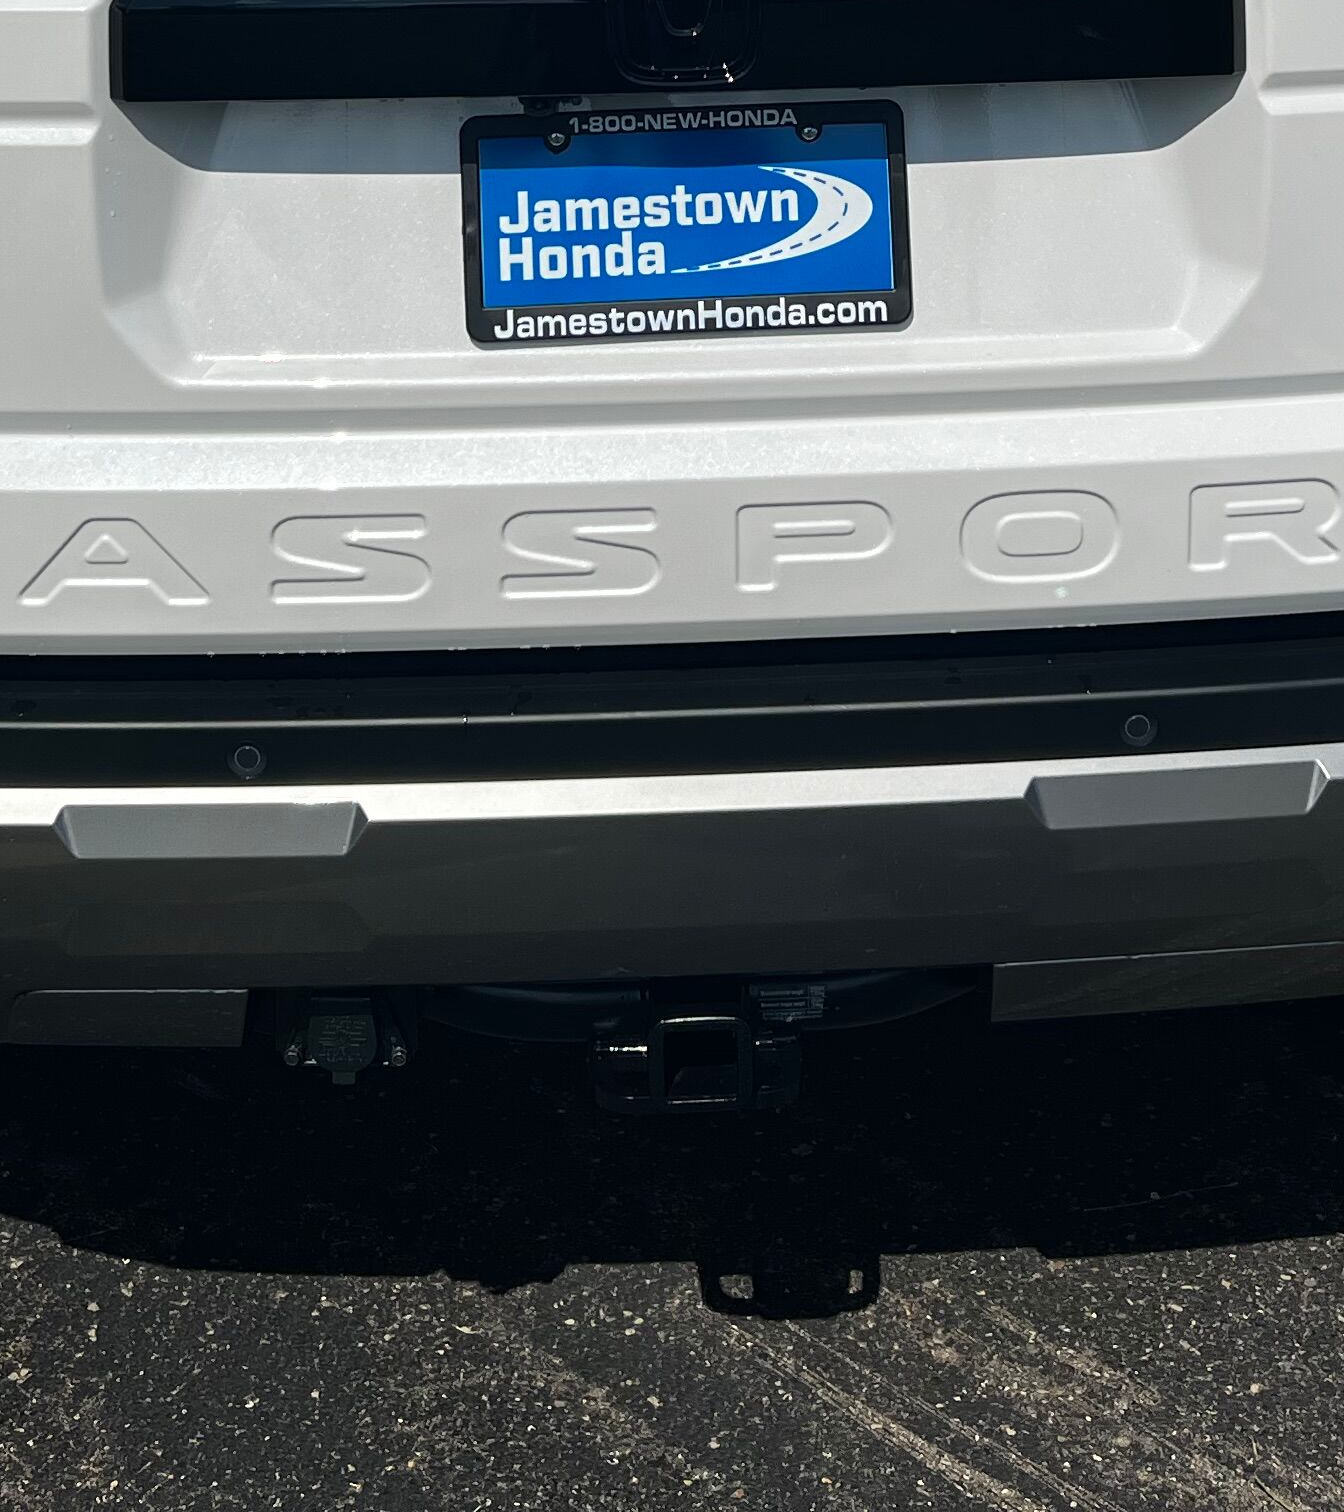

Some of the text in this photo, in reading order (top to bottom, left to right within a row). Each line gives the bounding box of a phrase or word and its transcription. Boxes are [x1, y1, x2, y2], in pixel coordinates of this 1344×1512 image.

[568, 108, 798, 134] 1-800-NEW-HONDA
[499, 185, 800, 235] Jamestown
[498, 230, 666, 282] Honda
[493, 297, 888, 340] JamestownHonda.com
